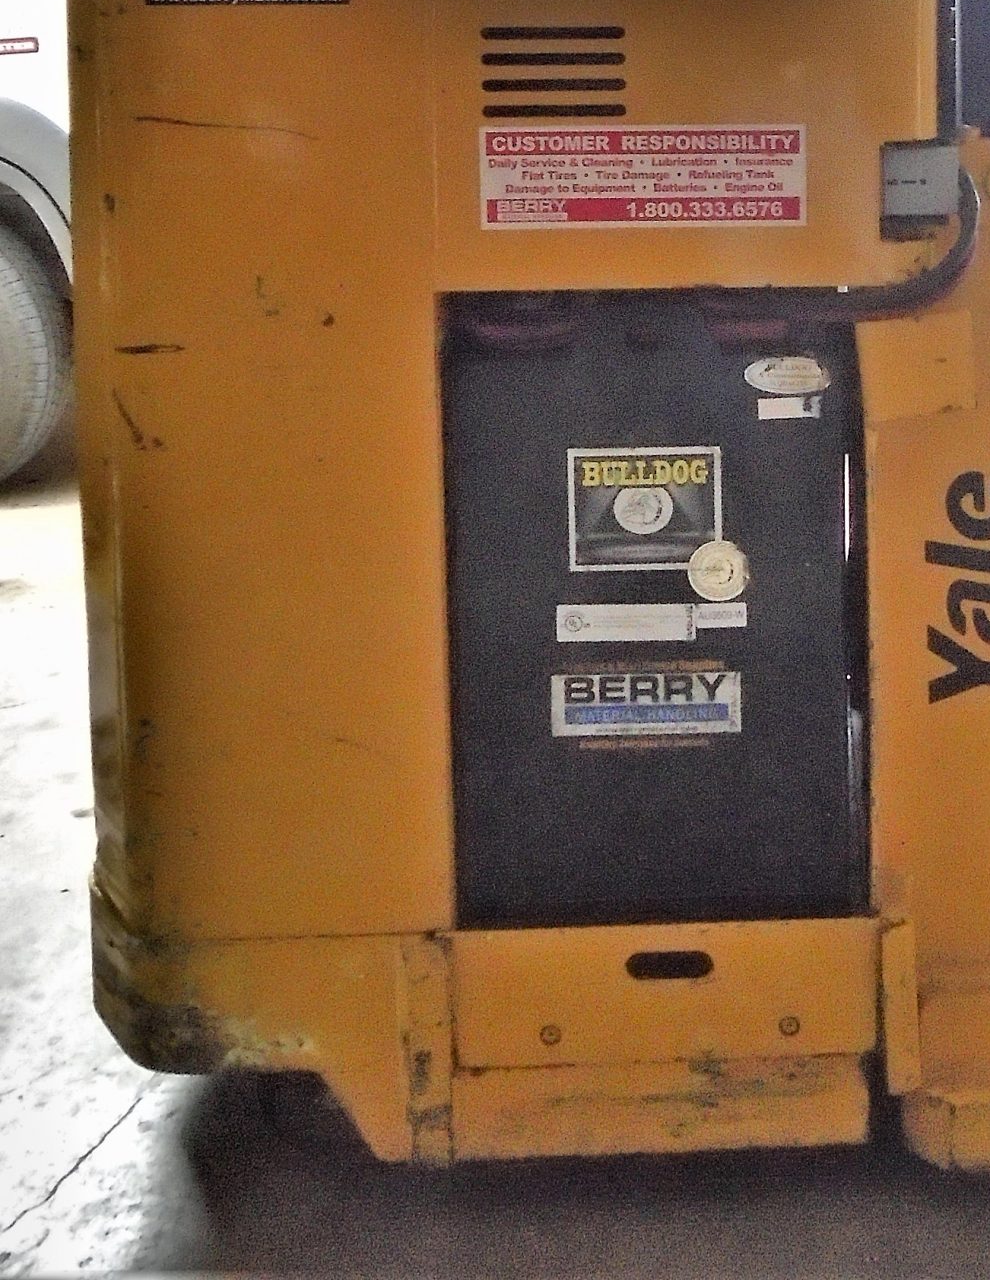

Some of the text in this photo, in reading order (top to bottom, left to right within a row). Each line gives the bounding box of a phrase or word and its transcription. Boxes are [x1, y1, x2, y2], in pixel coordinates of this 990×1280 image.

[492, 134, 796, 152] CUSTOMER RESPONSIBILITY
[488, 157, 794, 169] Daily Service & Cleaning Lubrication Insurance
[521, 170, 775, 181] Flat Tires Tire Damage Refueling Tank
[505, 182, 784, 195] Damage to Equipment Batteries Engine Oil
[496, 200, 783, 218] BERRY 1.800.333.6576
[582, 459, 709, 487] BULLDOG
[564, 674, 727, 704] BERRY
